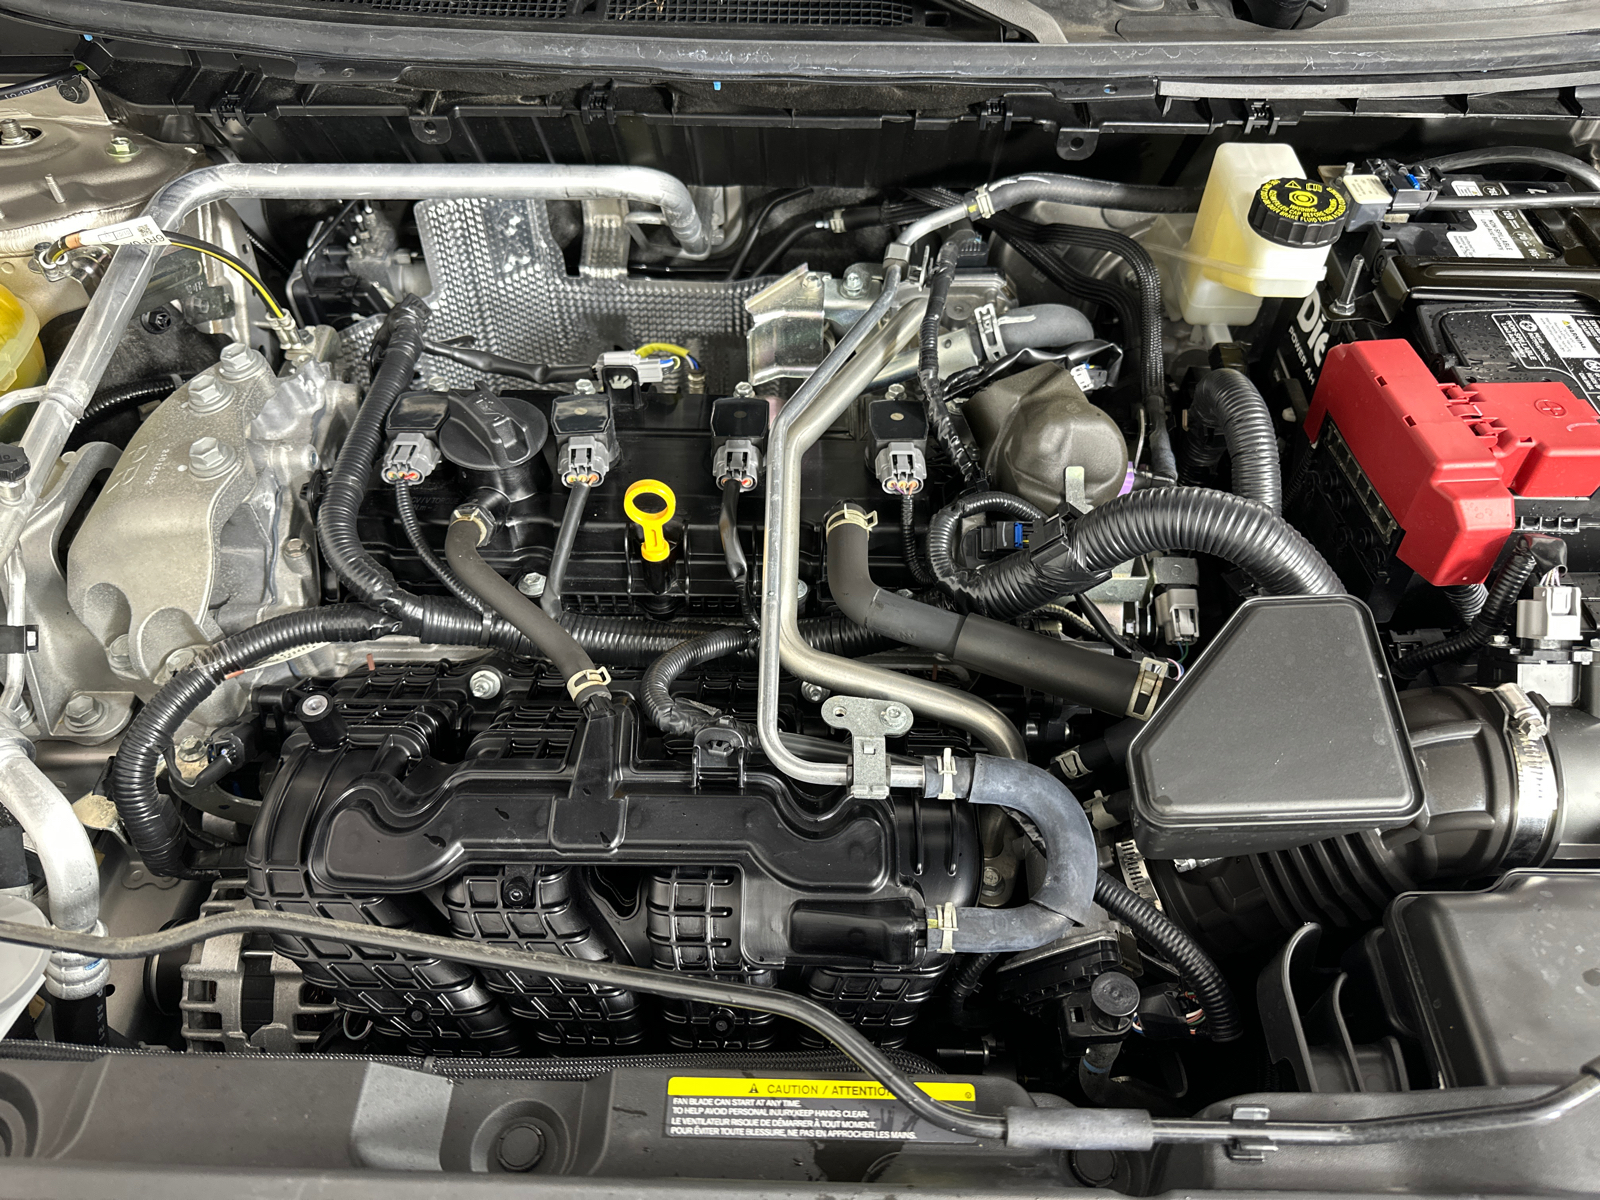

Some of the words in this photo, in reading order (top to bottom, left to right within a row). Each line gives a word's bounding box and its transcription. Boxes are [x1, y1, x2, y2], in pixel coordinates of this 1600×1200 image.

[1288, 325, 1307, 367] POWER
[767, 1084, 819, 1095] CAUTION
[689, 1098, 714, 1106] BLADE
[714, 1098, 731, 1106] CAN
[766, 1099, 780, 1107] ANY
[672, 1107, 684, 1115] TO
[684, 1107, 704, 1115] HELP
[704, 1107, 728, 1115] AVOID
[729, 1107, 769, 1116] PERSONAL
[842, 1110, 870, 1118] CLEAR.
[671, 1117, 682, 1125] LE
[682, 1117, 730, 1126] VENTILATEUR
[731, 1118, 759, 1126] RISQUE
[760, 1119, 771, 1127] DE
[821, 1120, 841, 1128] TOUT
[842, 1120, 877, 1129] MOMENT.
[670, 1126, 693, 1135] POUR
[720, 1127, 745, 1136] TOUTE
[787, 1129, 799, 1137] NE
[800, 1129, 815, 1137] PAS
[815, 1130, 827, 1138] EN
[827, 1130, 875, 1138] APPROCHER
